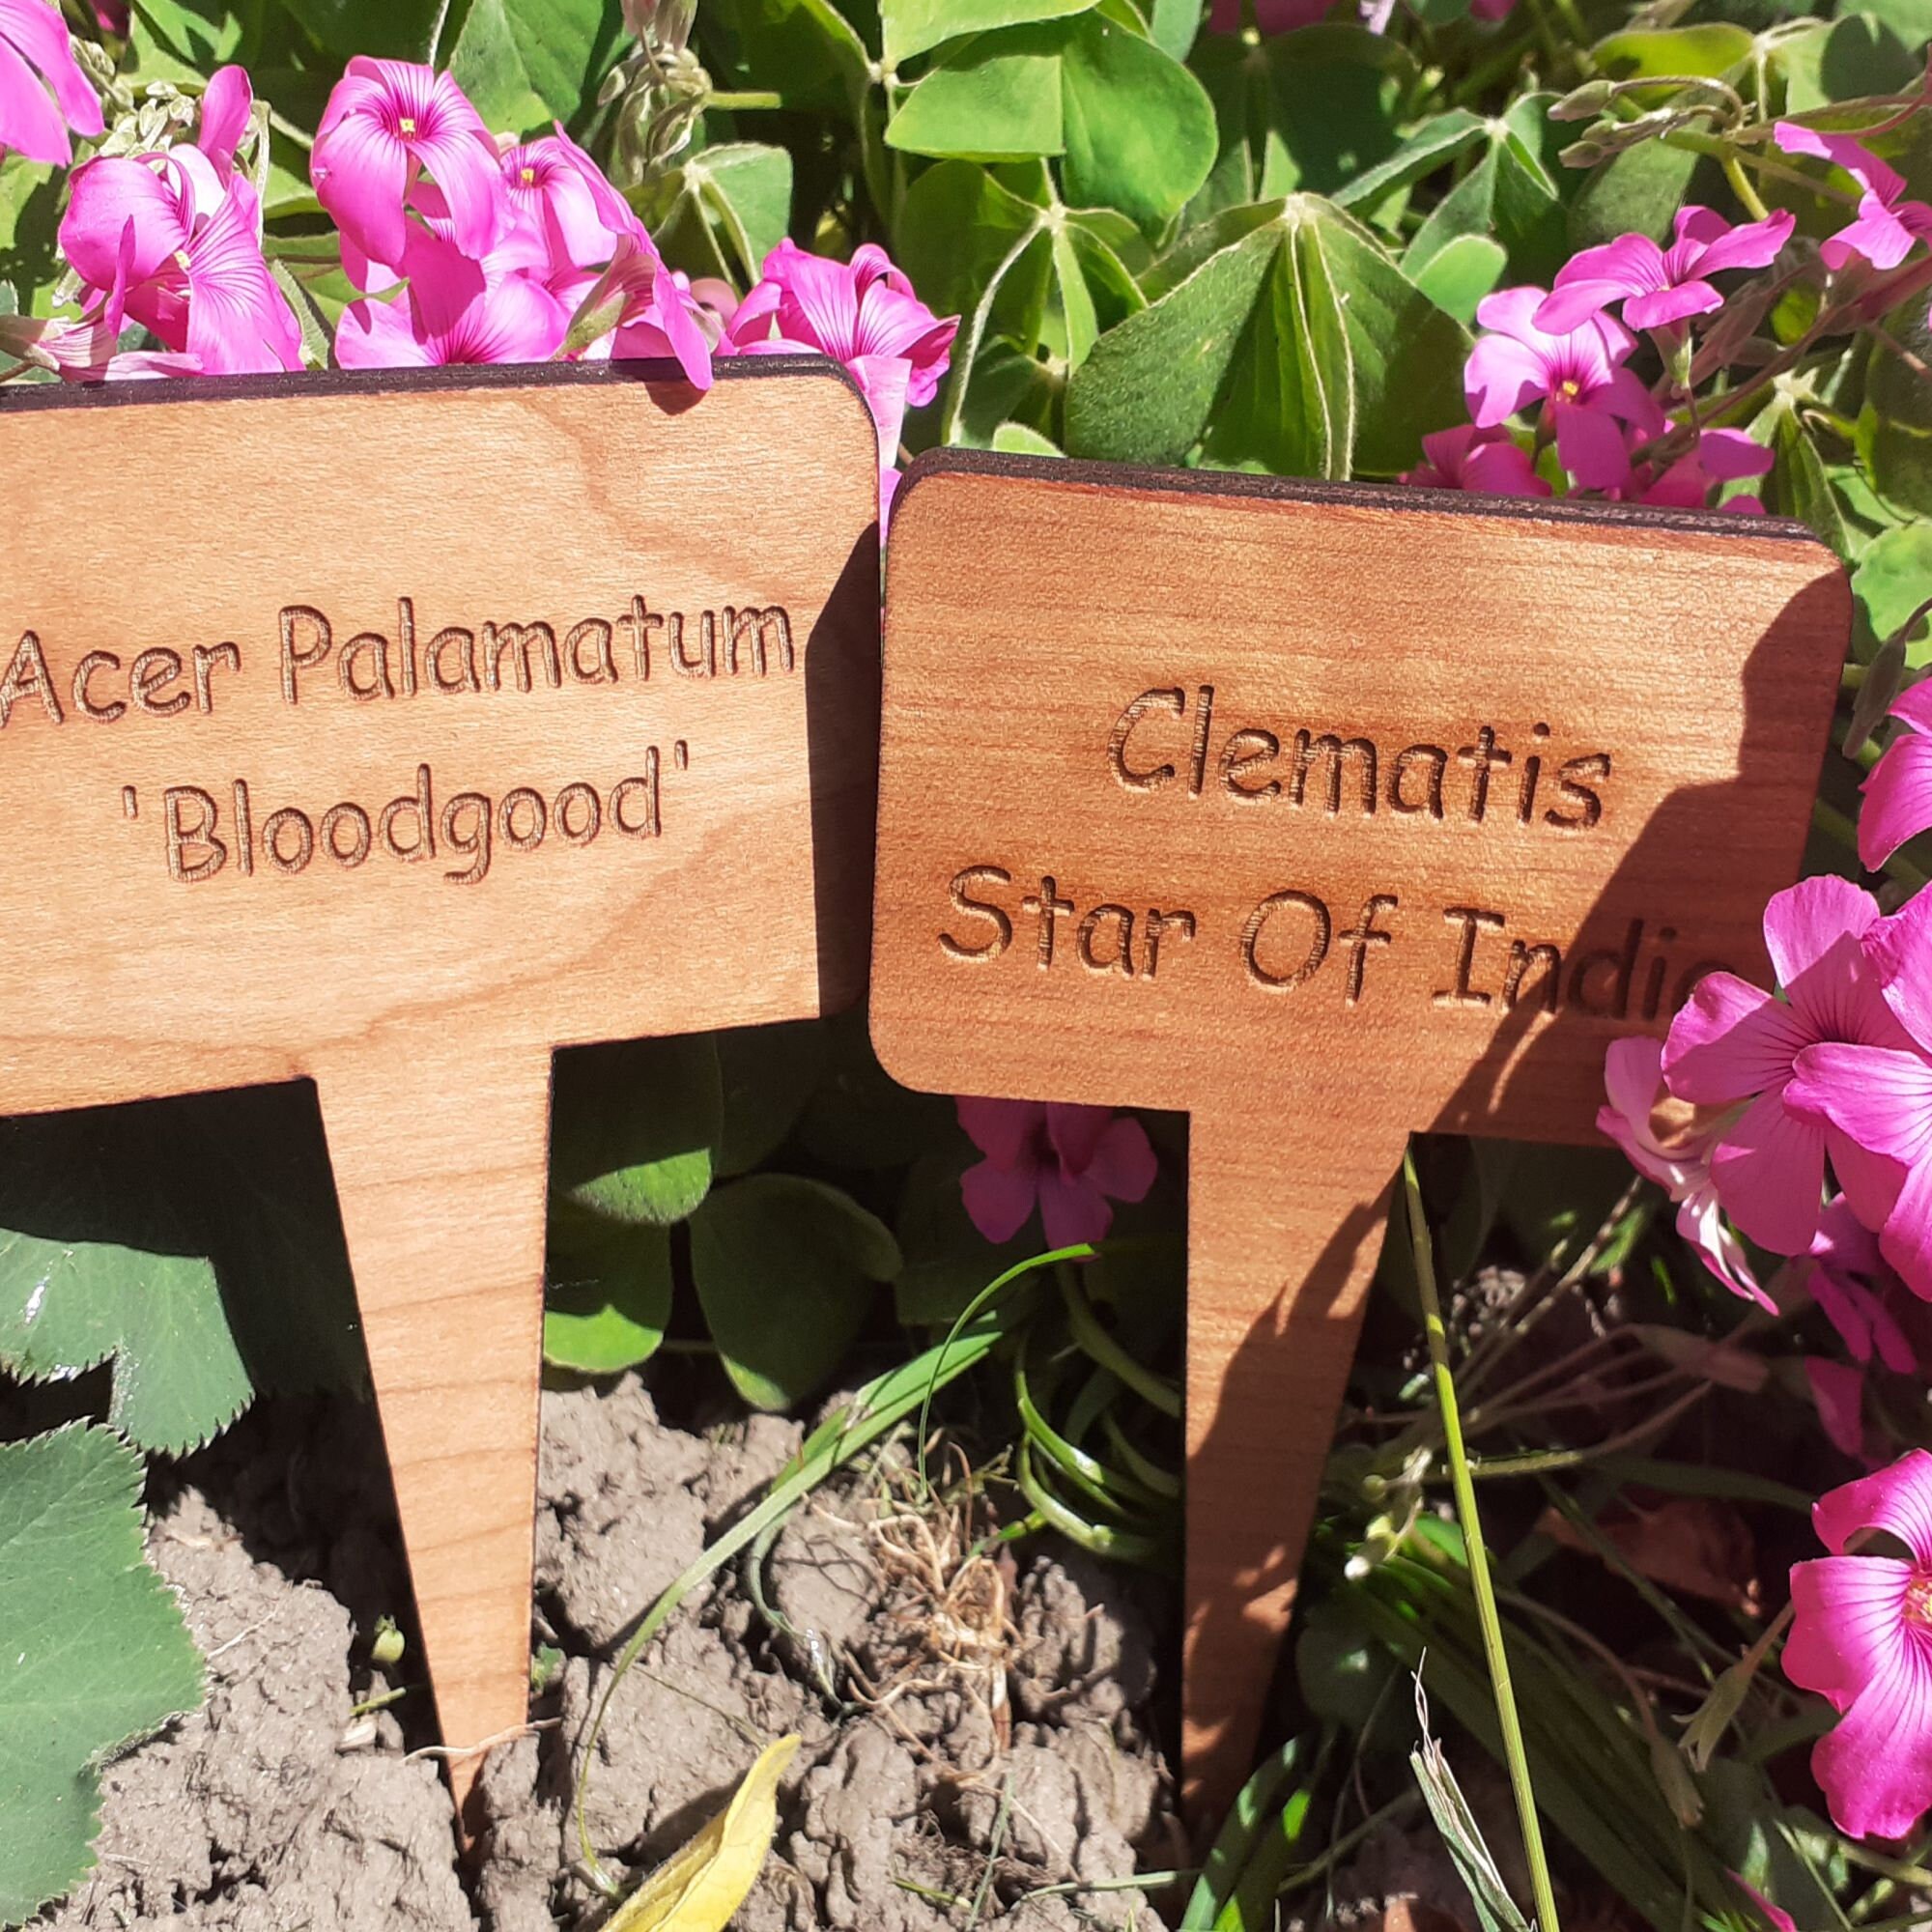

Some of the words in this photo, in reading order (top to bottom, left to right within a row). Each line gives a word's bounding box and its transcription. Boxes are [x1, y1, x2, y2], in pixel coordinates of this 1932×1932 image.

[0, 630, 242, 729] Acer
[277, 593, 796, 705] Palamatum
[121, 739, 690, 885] 'Bloodgood'
[1107, 684, 1610, 833] Clematis
[937, 864, 1196, 980] Star
[1240, 889, 1398, 1007] Of
